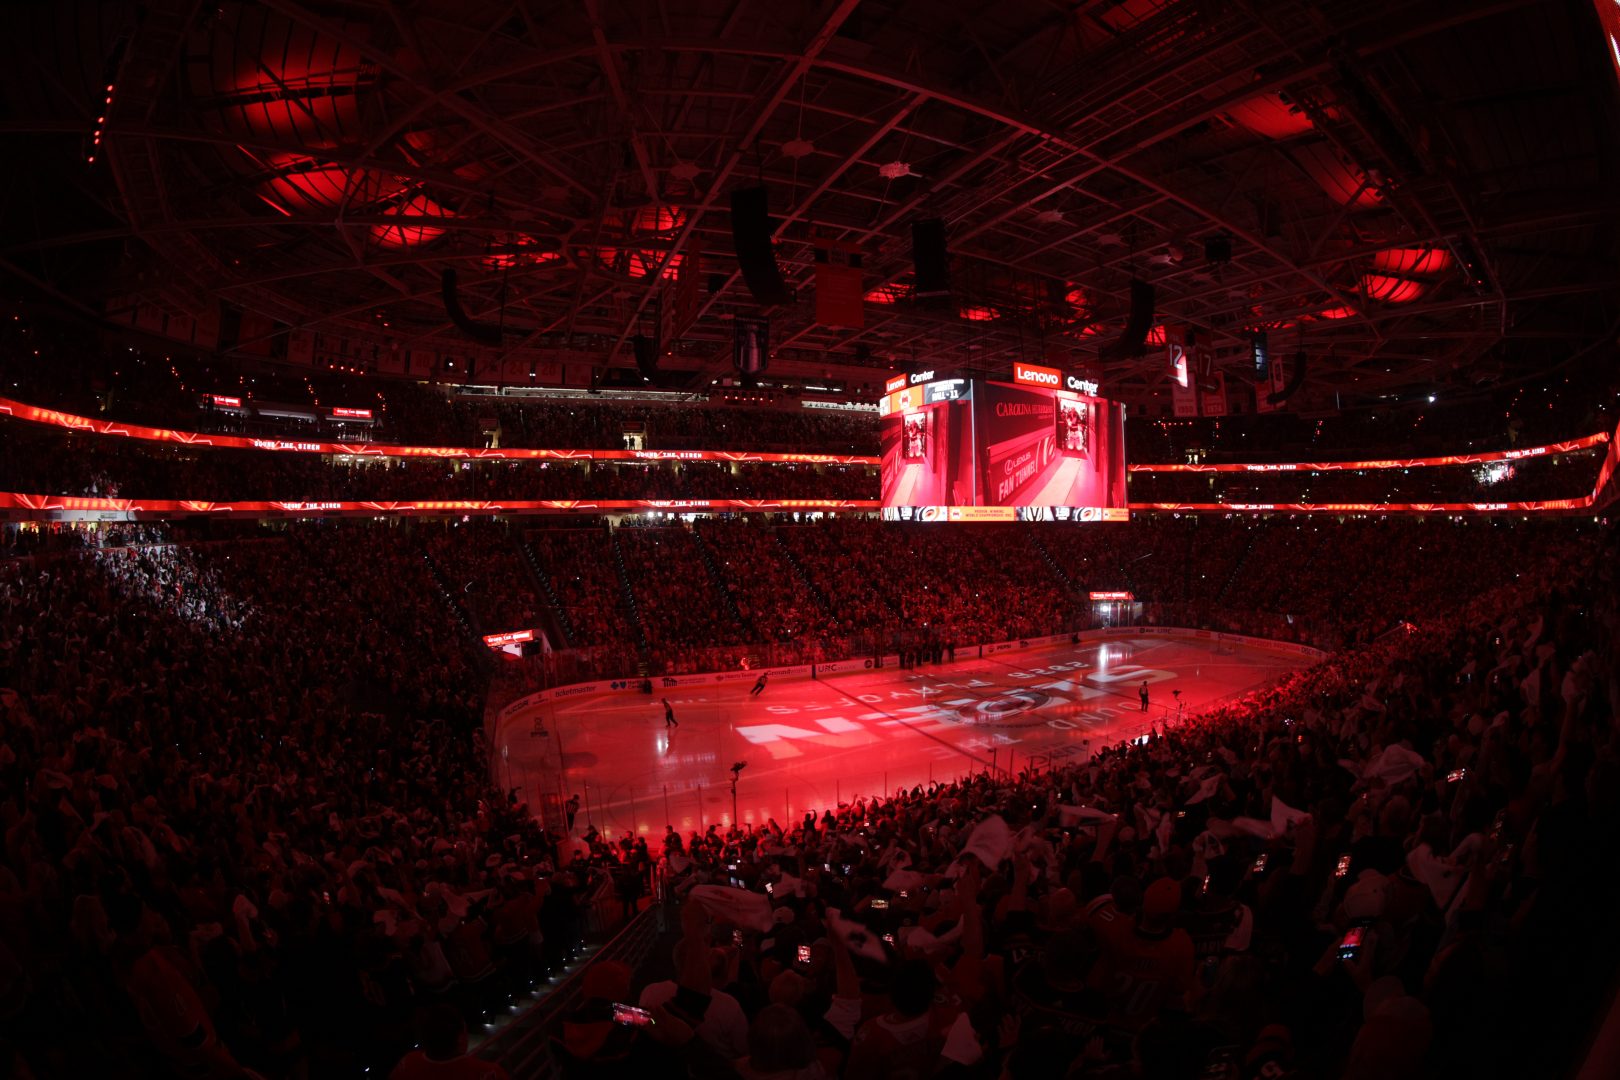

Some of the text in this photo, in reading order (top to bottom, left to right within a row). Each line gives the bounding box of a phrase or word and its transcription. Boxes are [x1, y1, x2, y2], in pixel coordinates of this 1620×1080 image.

[1168, 343, 1183, 370] 12
[887, 378, 905, 392] Lenovo
[910, 370, 935, 384] Center
[1017, 366, 1099, 393] Lenovo Center
[996, 401, 1032, 417] CAROLINA
[999, 460, 1036, 502] FAN TUNNEL
[996, 643, 1012, 651] PEPSI
[818, 663, 838, 673] UNC
[555, 685, 597, 698] ticketmaster
[765, 678, 996, 715] PLAYOFFS
